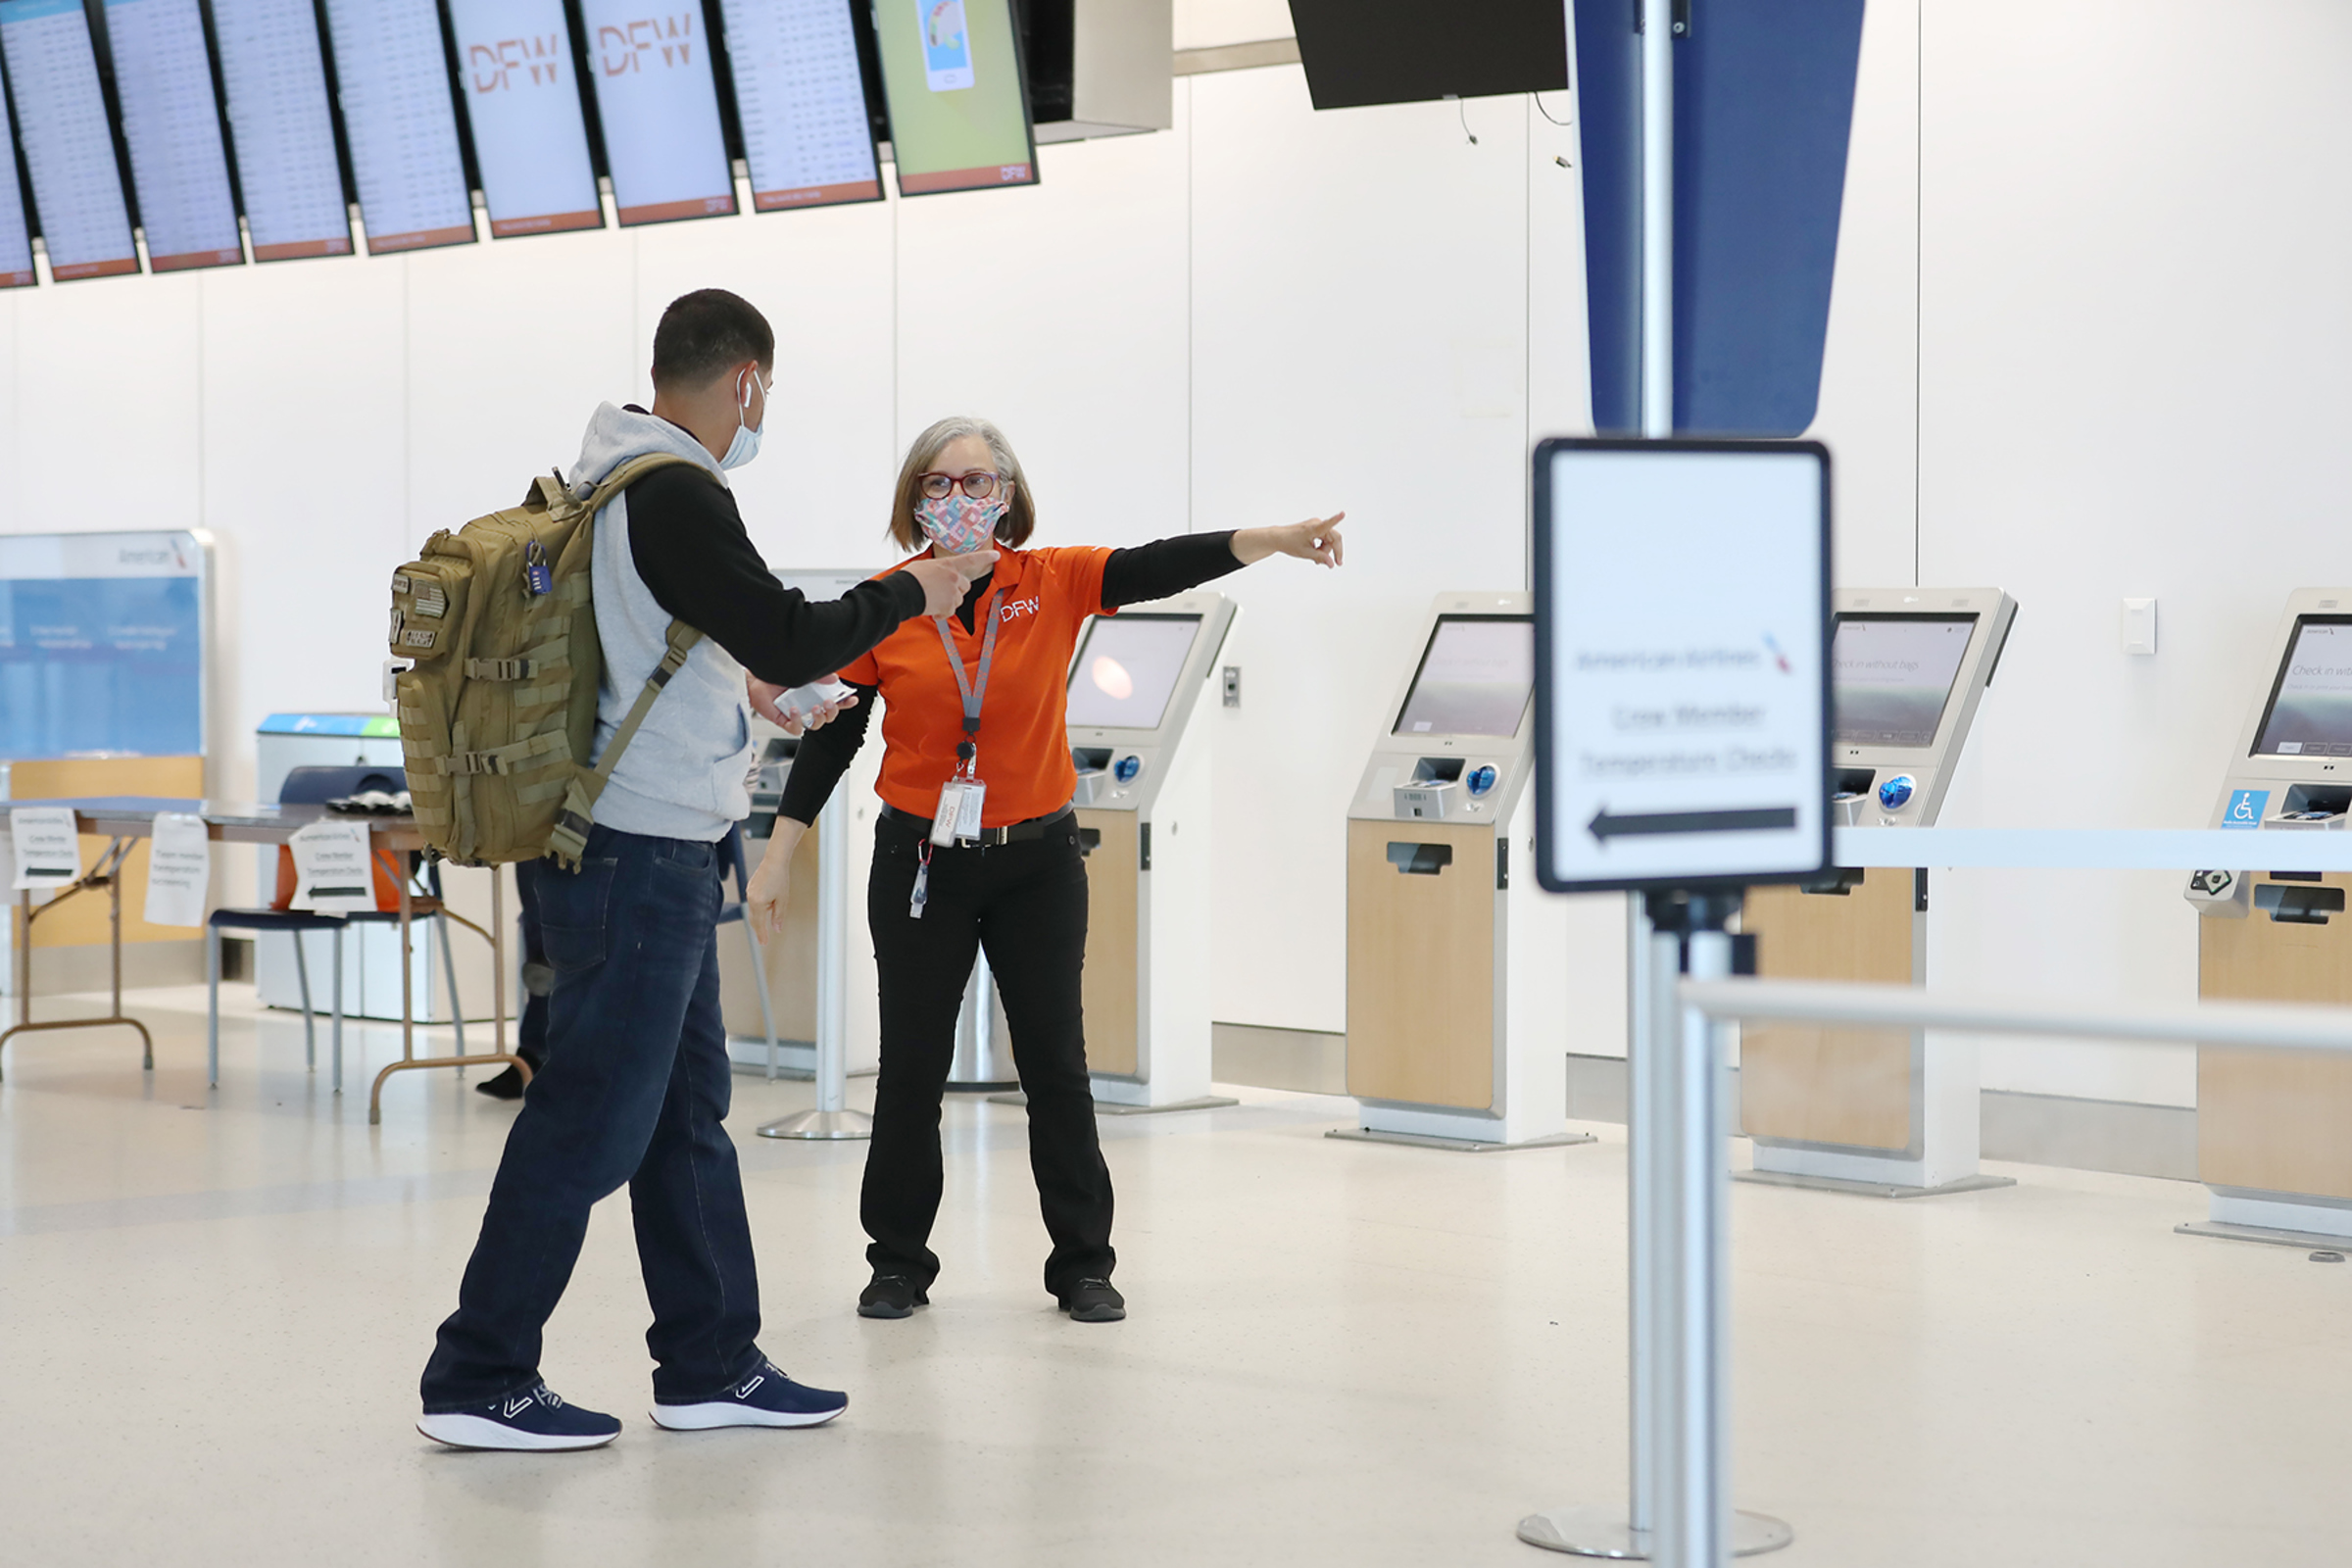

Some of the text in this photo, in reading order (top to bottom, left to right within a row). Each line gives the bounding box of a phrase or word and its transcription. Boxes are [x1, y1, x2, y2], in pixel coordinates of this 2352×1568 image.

[599, 13, 692, 77] DFW
[468, 33, 559, 94] DFW
[1000, 164, 1026, 182] DFW
[1000, 596, 1040, 623] DFW
[941, 631, 959, 658] DFW
[981, 630, 996, 659] DFW
[1865, 660, 1899, 669] without
[1899, 660, 1919, 672] bags
[2292, 664, 2323, 676] Check
[2325, 665, 2333, 676] in
[955, 668, 971, 697] DFW
[973, 669, 988, 699] DFW
[1673, 702, 1766, 727] Member
